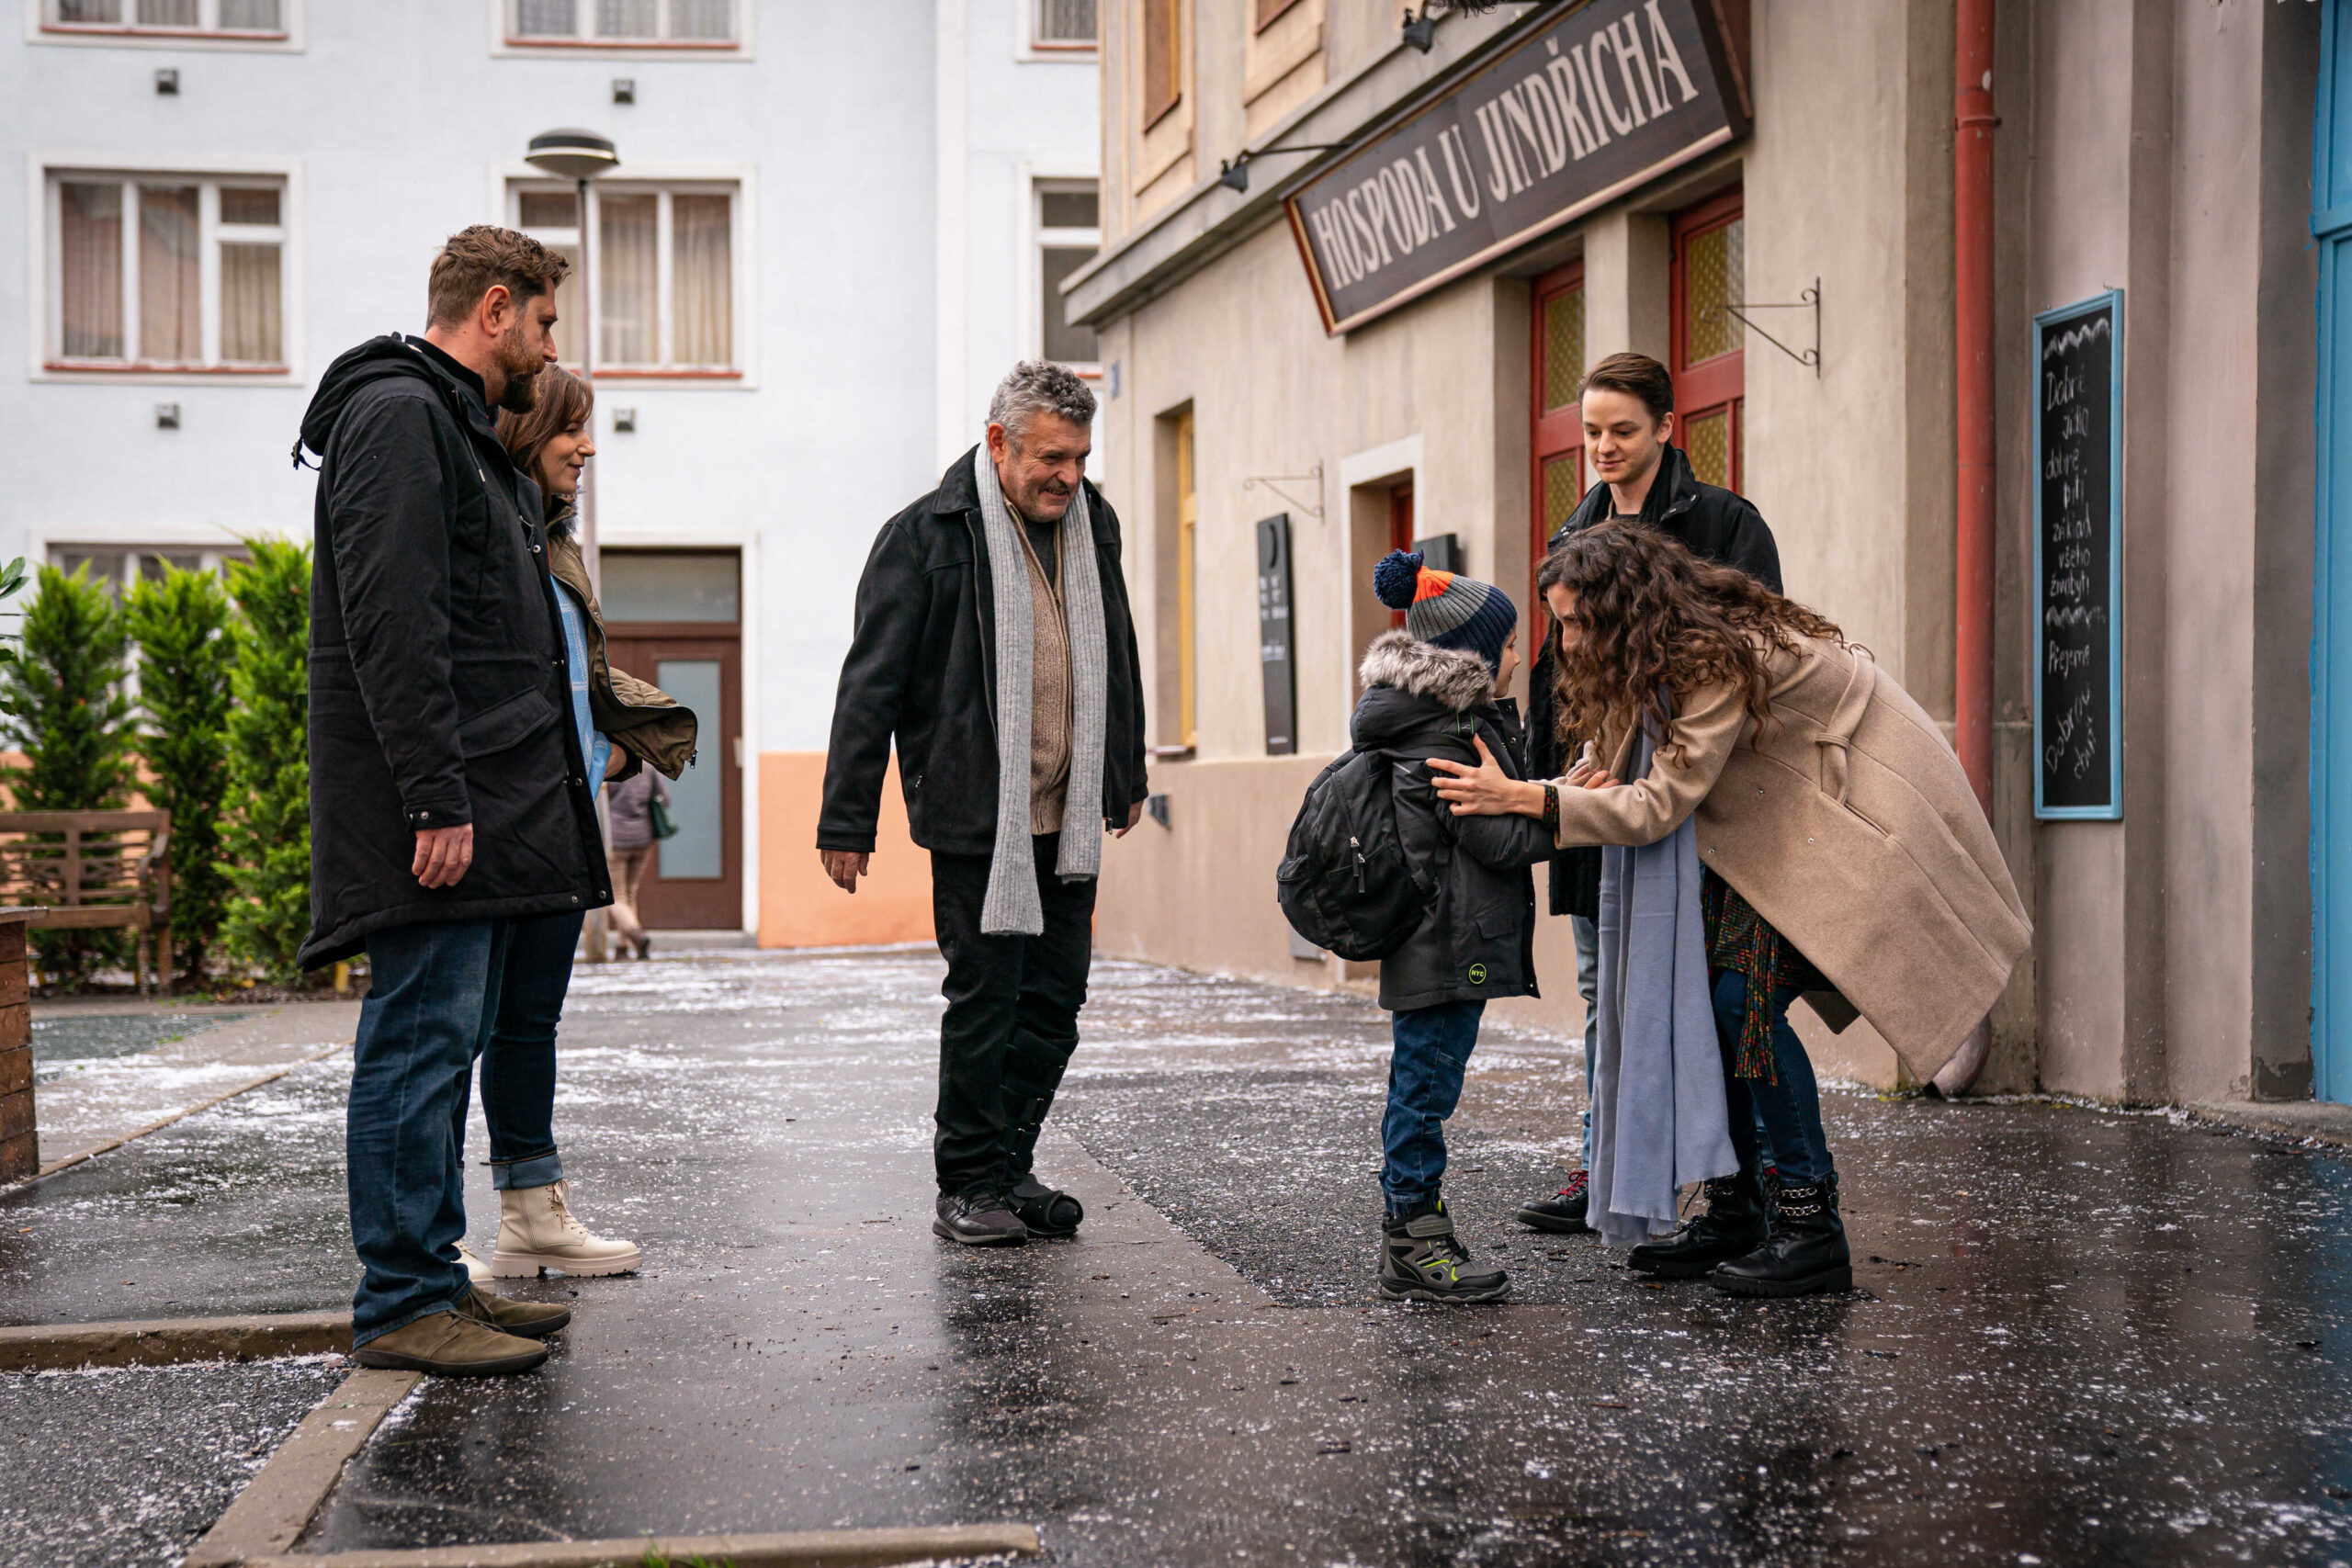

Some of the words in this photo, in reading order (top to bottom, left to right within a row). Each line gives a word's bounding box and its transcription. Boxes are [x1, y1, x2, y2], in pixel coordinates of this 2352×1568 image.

[1311, 146, 1456, 290] HOSPODA
[1437, 124, 1480, 219] U
[1476, 0, 1699, 202] JINDŘICHA
[1471, 969, 1485, 977] NYC
